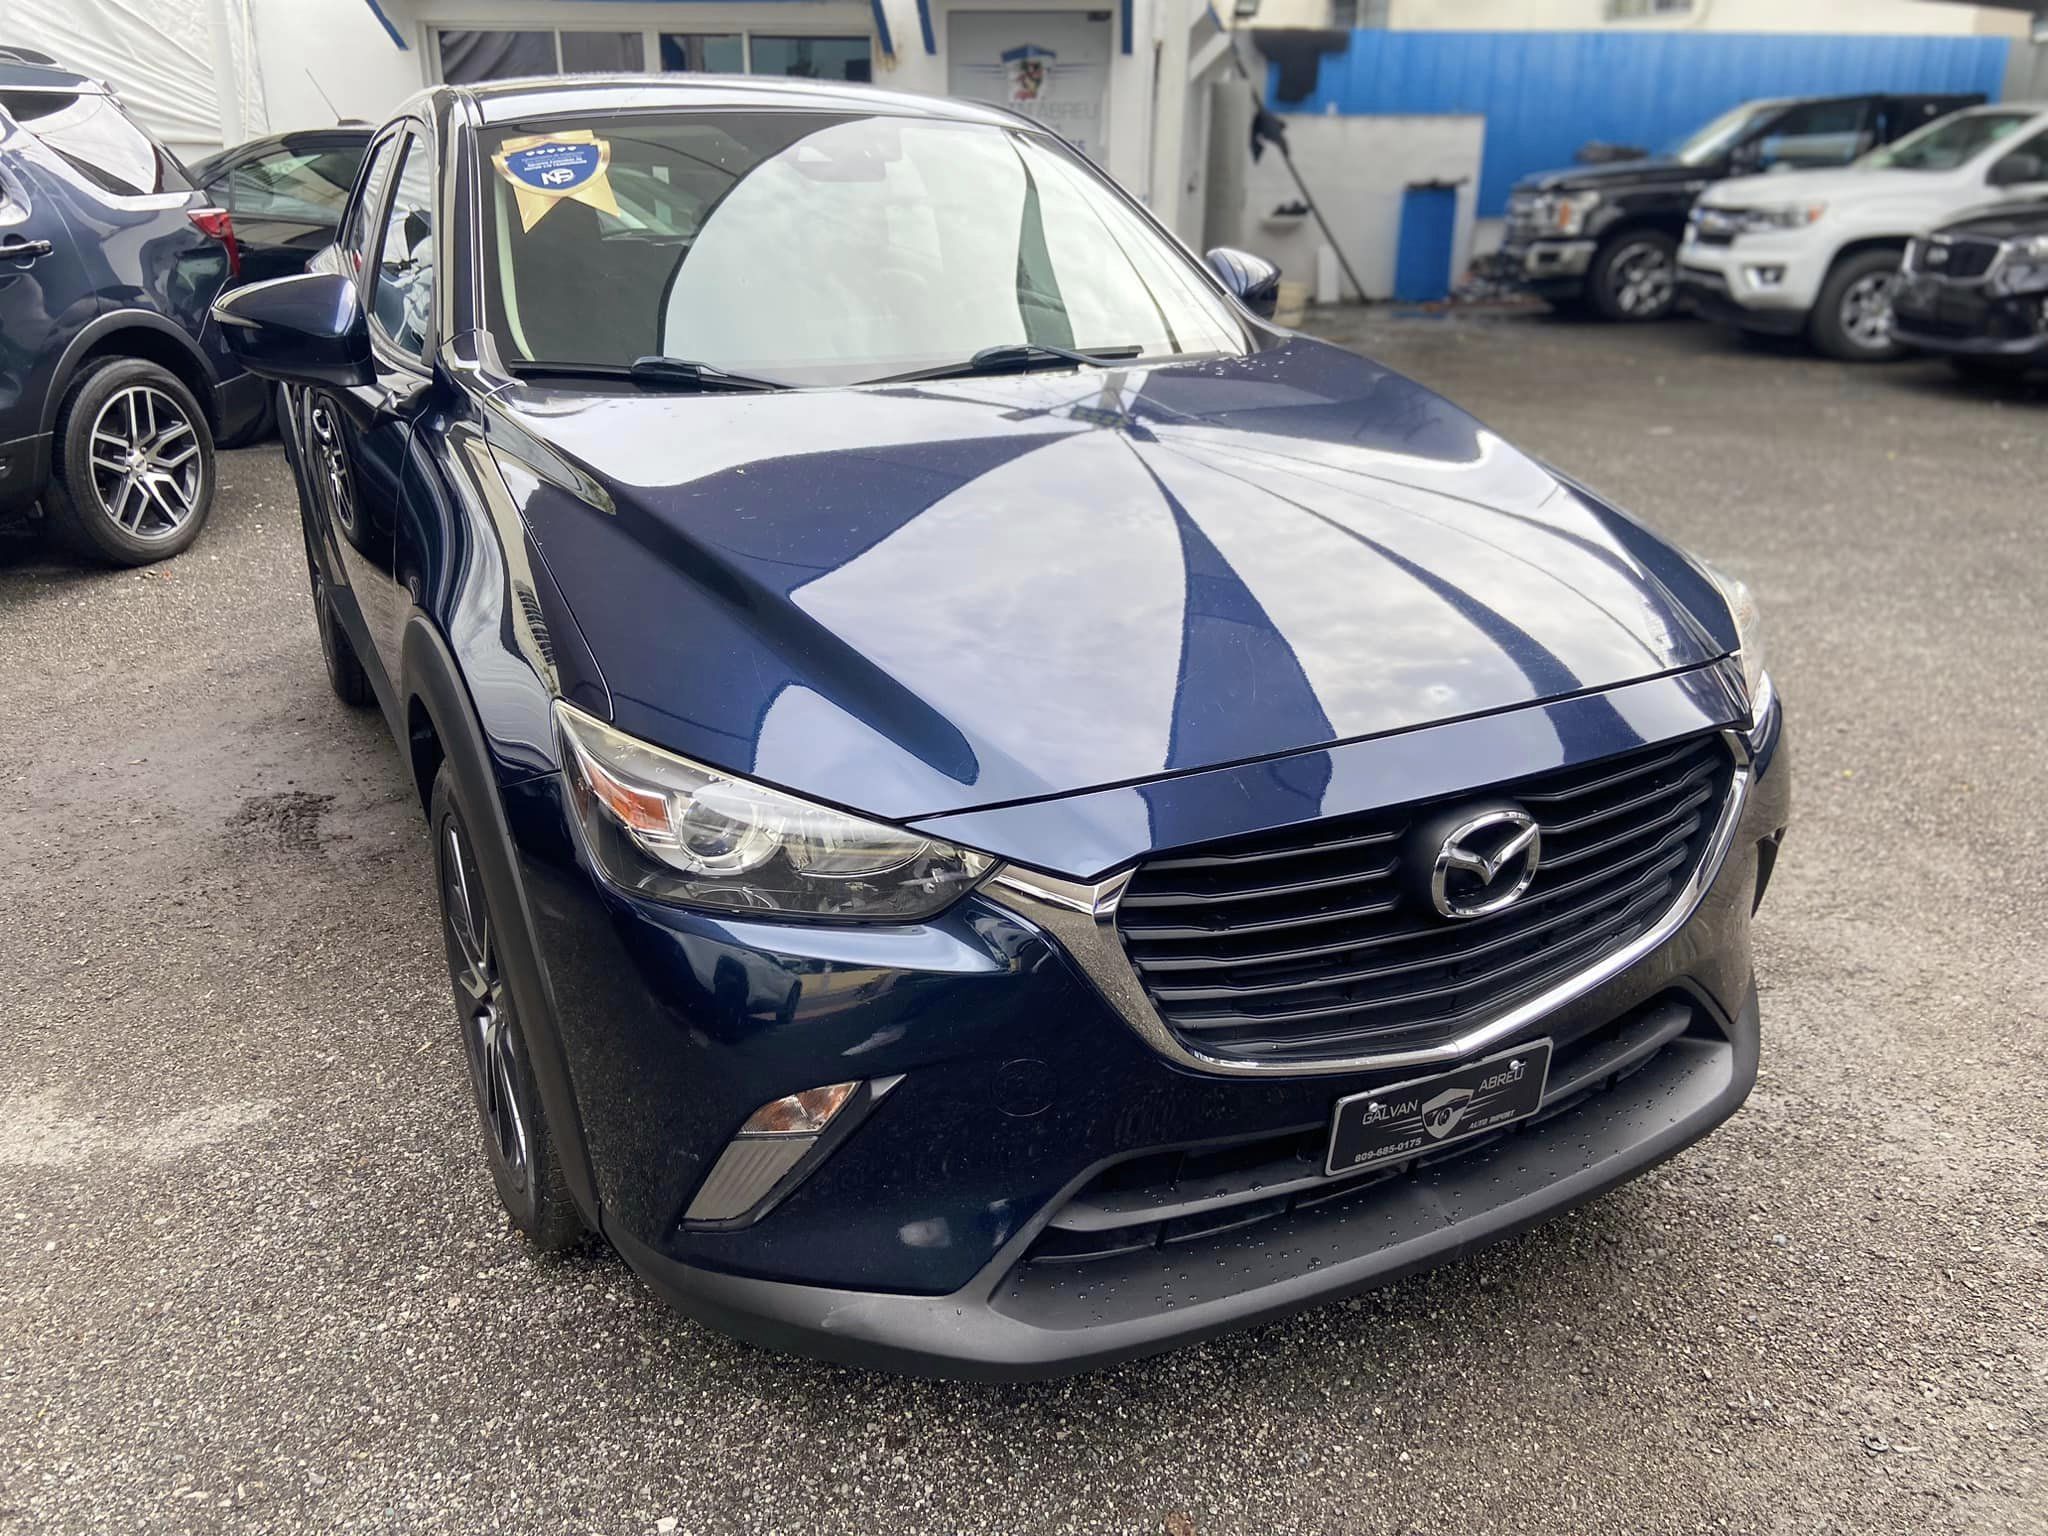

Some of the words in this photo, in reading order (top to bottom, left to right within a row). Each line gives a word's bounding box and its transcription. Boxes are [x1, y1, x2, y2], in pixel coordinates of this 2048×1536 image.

[1362, 1099, 1418, 1125] GALVAN
[1478, 1066, 1525, 1092] ABREU
[1354, 1137, 1422, 1162] 809-685-0175
